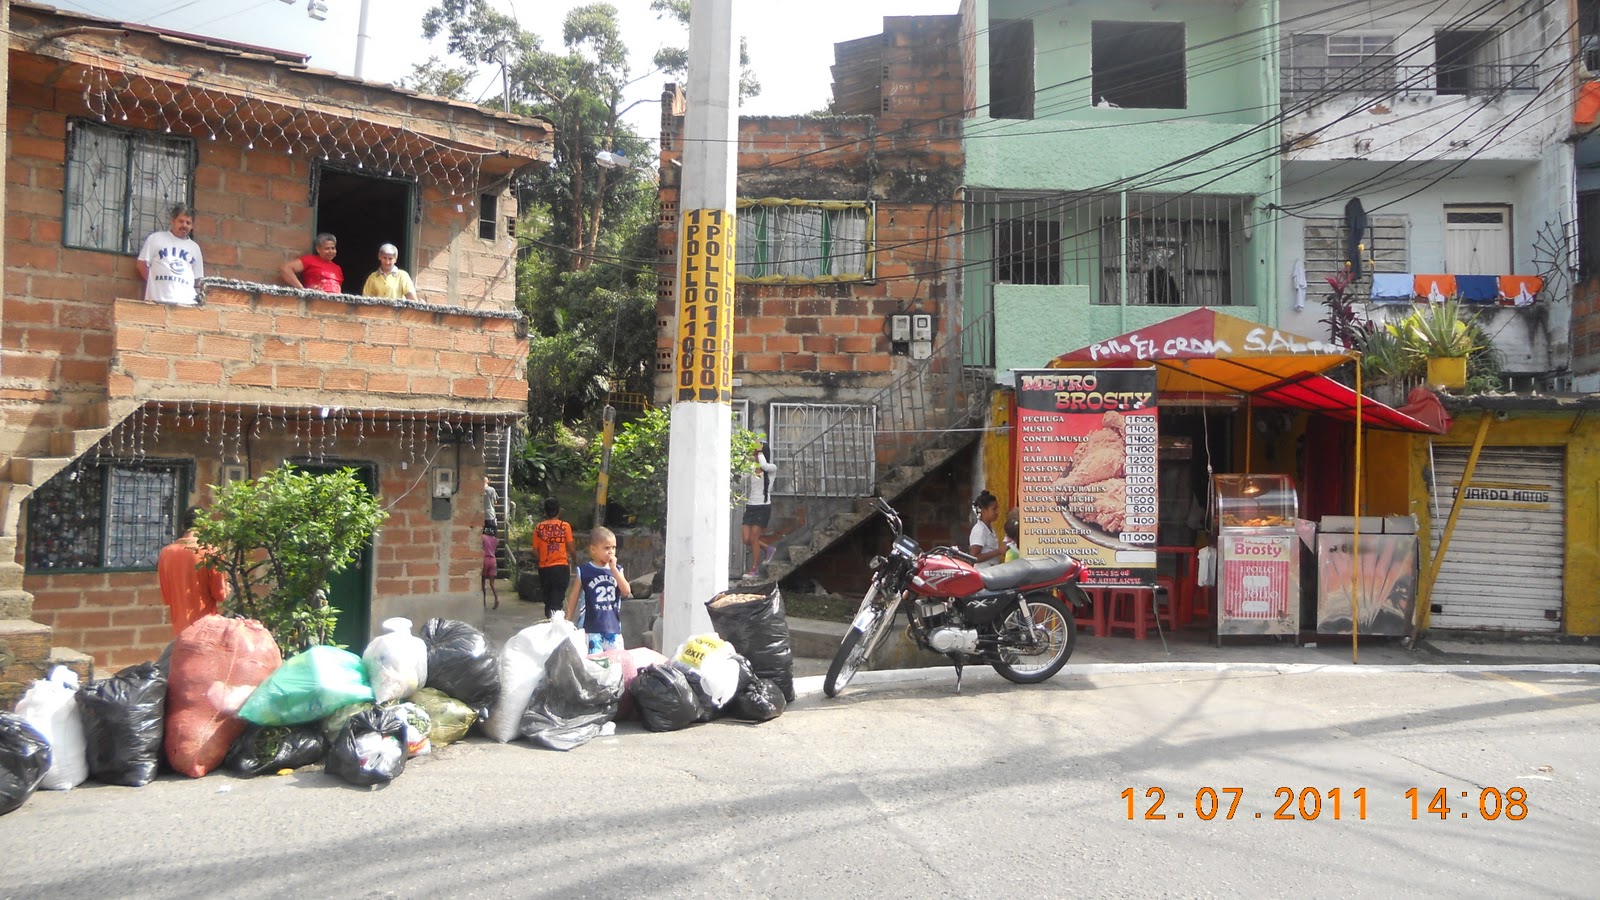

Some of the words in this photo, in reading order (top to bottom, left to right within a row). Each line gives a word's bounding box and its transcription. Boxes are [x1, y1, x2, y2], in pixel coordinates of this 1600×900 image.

[1020, 374, 1098, 392] METRO
[1054, 391, 1152, 411] BROSTY
[1022, 415, 1065, 423] PECHUGA
[1022, 425, 1053, 433] MUSLO
[1128, 425, 1156, 433] 1400
[1022, 435, 1089, 443] CONTRAMUSLO
[1023, 445, 1041, 453] ALA
[1128, 446, 1155, 454] 1400
[1023, 455, 1074, 463] RABADILLA
[1023, 475, 1054, 483] MALTA
[1055, 485, 1107, 493] NATURALES
[1128, 486, 1155, 494] 1000
[1513, 491, 1549, 502] MOTOS
[1133, 505, 1155, 513] 800
[1031, 528, 1058, 536] POLLO
[1059, 528, 1092, 536] ENTERO
[1027, 547, 1041, 555] LA
[1042, 547, 1099, 556] PROMOCION
[1234, 543, 1282, 558] Brosty
[1246, 566, 1275, 574] POLLO
[595, 585, 616, 602] 23
[1244, 590, 1279, 599] POLLO
